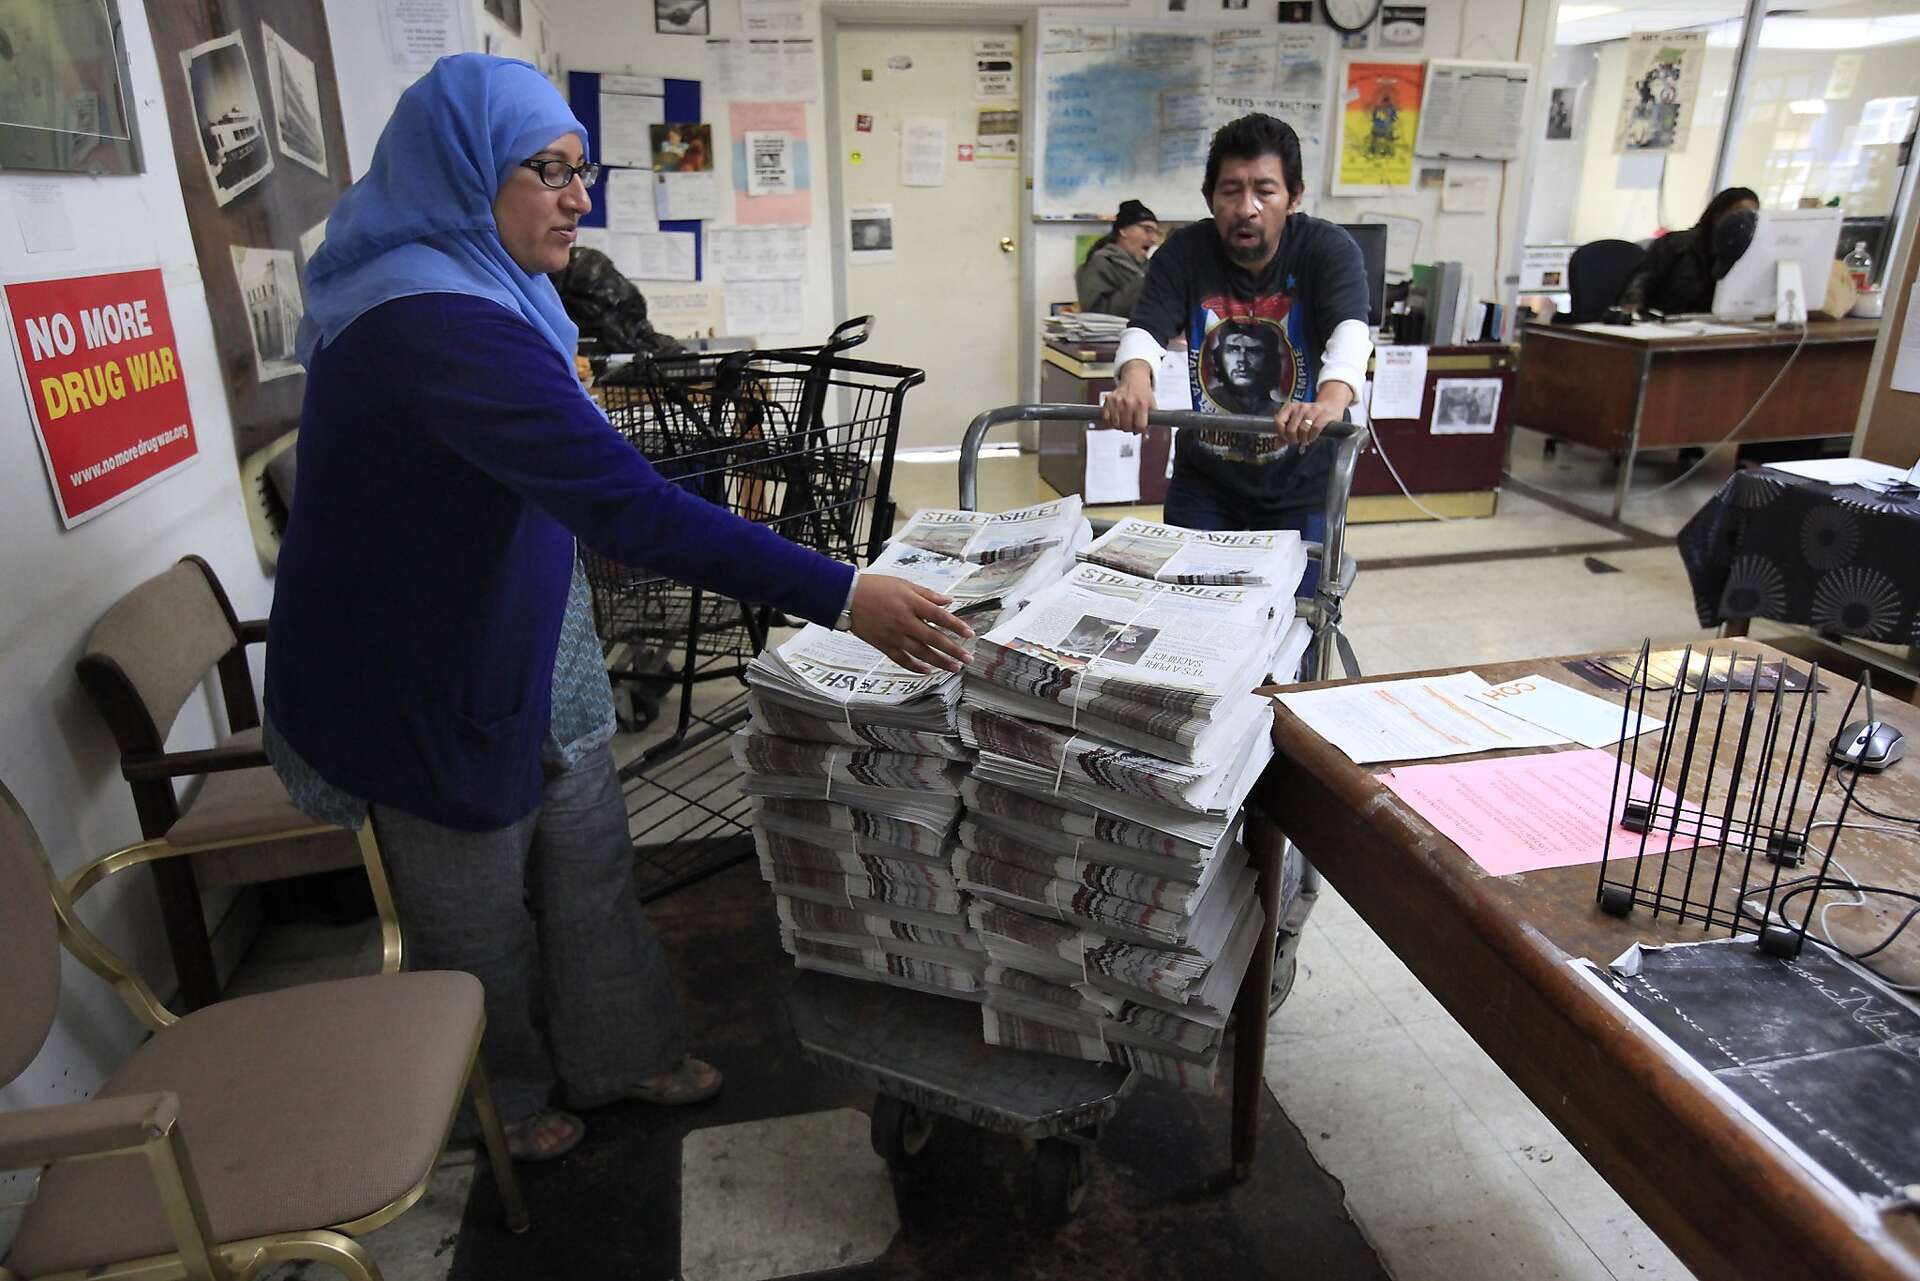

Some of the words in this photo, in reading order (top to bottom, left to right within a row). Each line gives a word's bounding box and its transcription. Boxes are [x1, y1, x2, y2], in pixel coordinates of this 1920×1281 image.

[25, 313, 76, 361] NO
[80, 300, 153, 350] MORE
[41, 361, 126, 420] DRUG
[126, 347, 178, 392] WAR
[1189, 350, 1200, 397] HASTA
[1293, 349, 1306, 403] EMPRE
[70, 424, 189, 487] www.nomoredrugwar.org
[999, 504, 1060, 523] SHEET
[1208, 531, 1279, 547] SHEET
[1169, 583, 1248, 599] SHEET
[1482, 682, 1537, 700] COH
